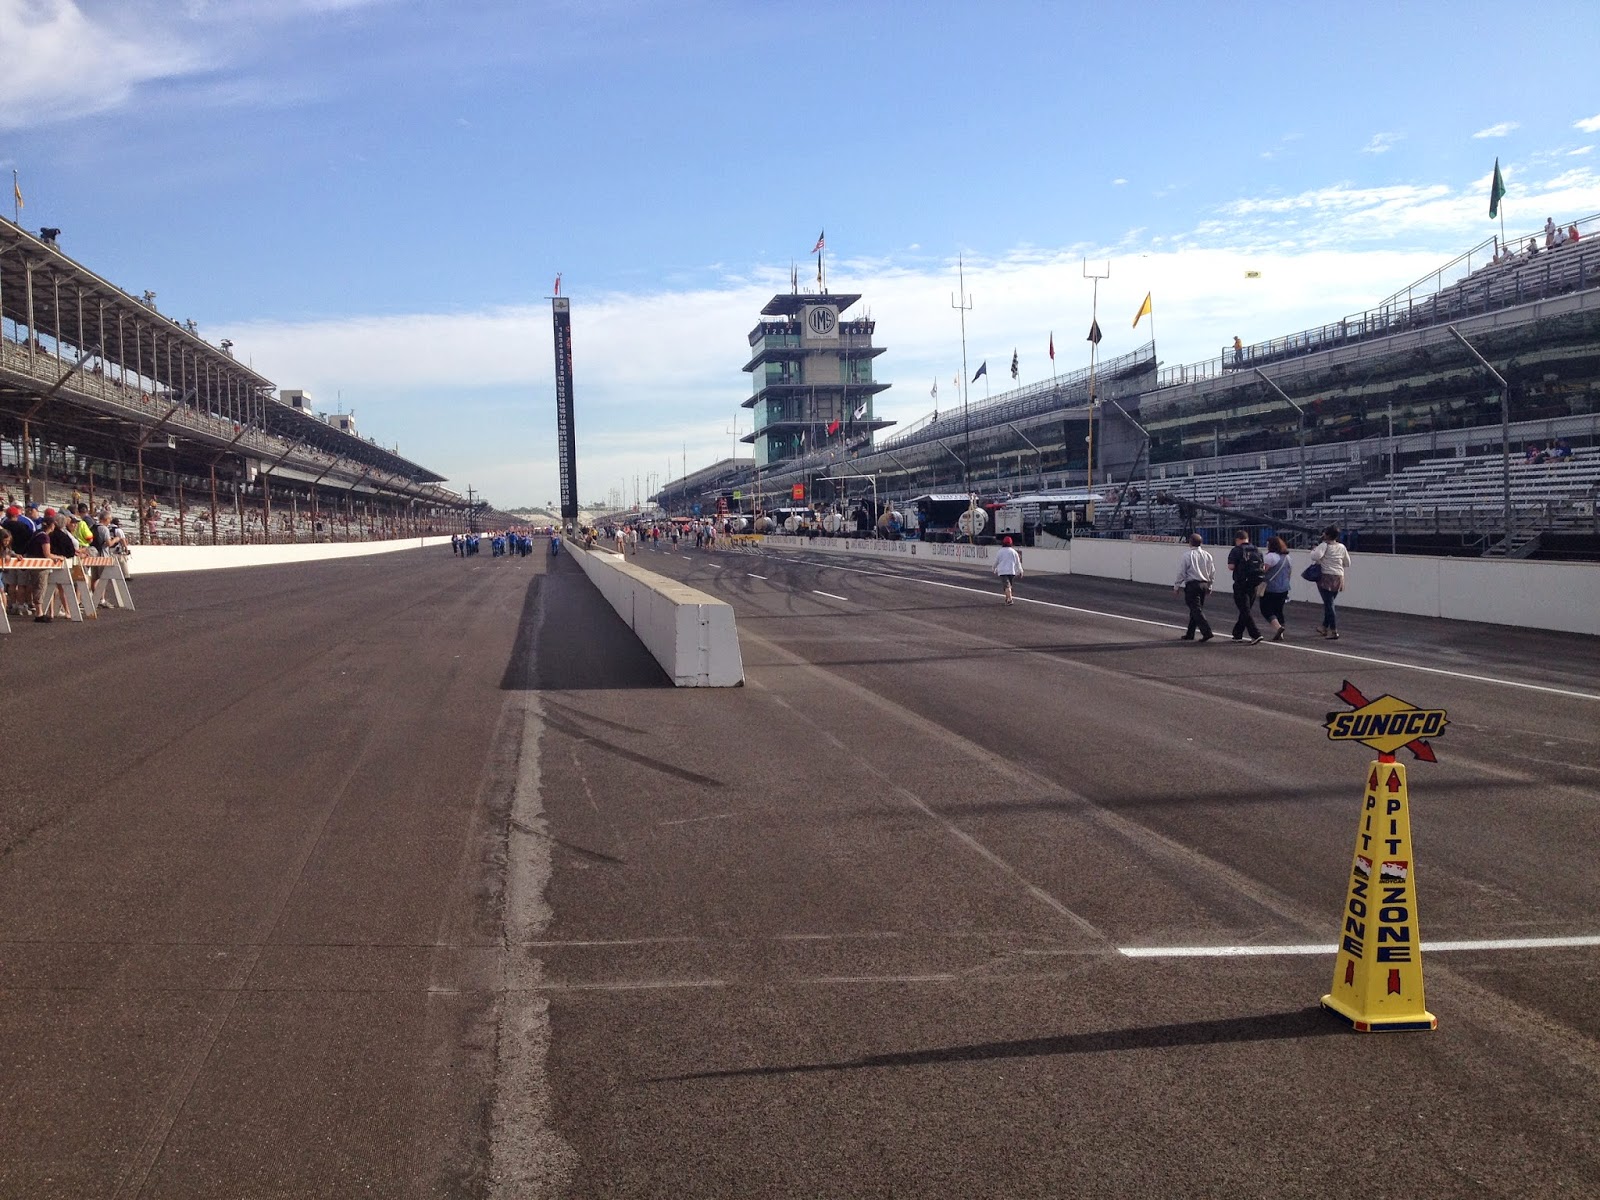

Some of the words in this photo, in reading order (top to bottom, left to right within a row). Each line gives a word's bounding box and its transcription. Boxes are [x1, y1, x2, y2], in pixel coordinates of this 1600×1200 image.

[813, 310, 831, 330] IMS
[1332, 712, 1443, 737] SUNOCO
[1361, 794, 1376, 851] PIT
[1384, 799, 1402, 855] PIT
[1342, 878, 1369, 960] ZONE
[1377, 887, 1412, 963] ZONE
